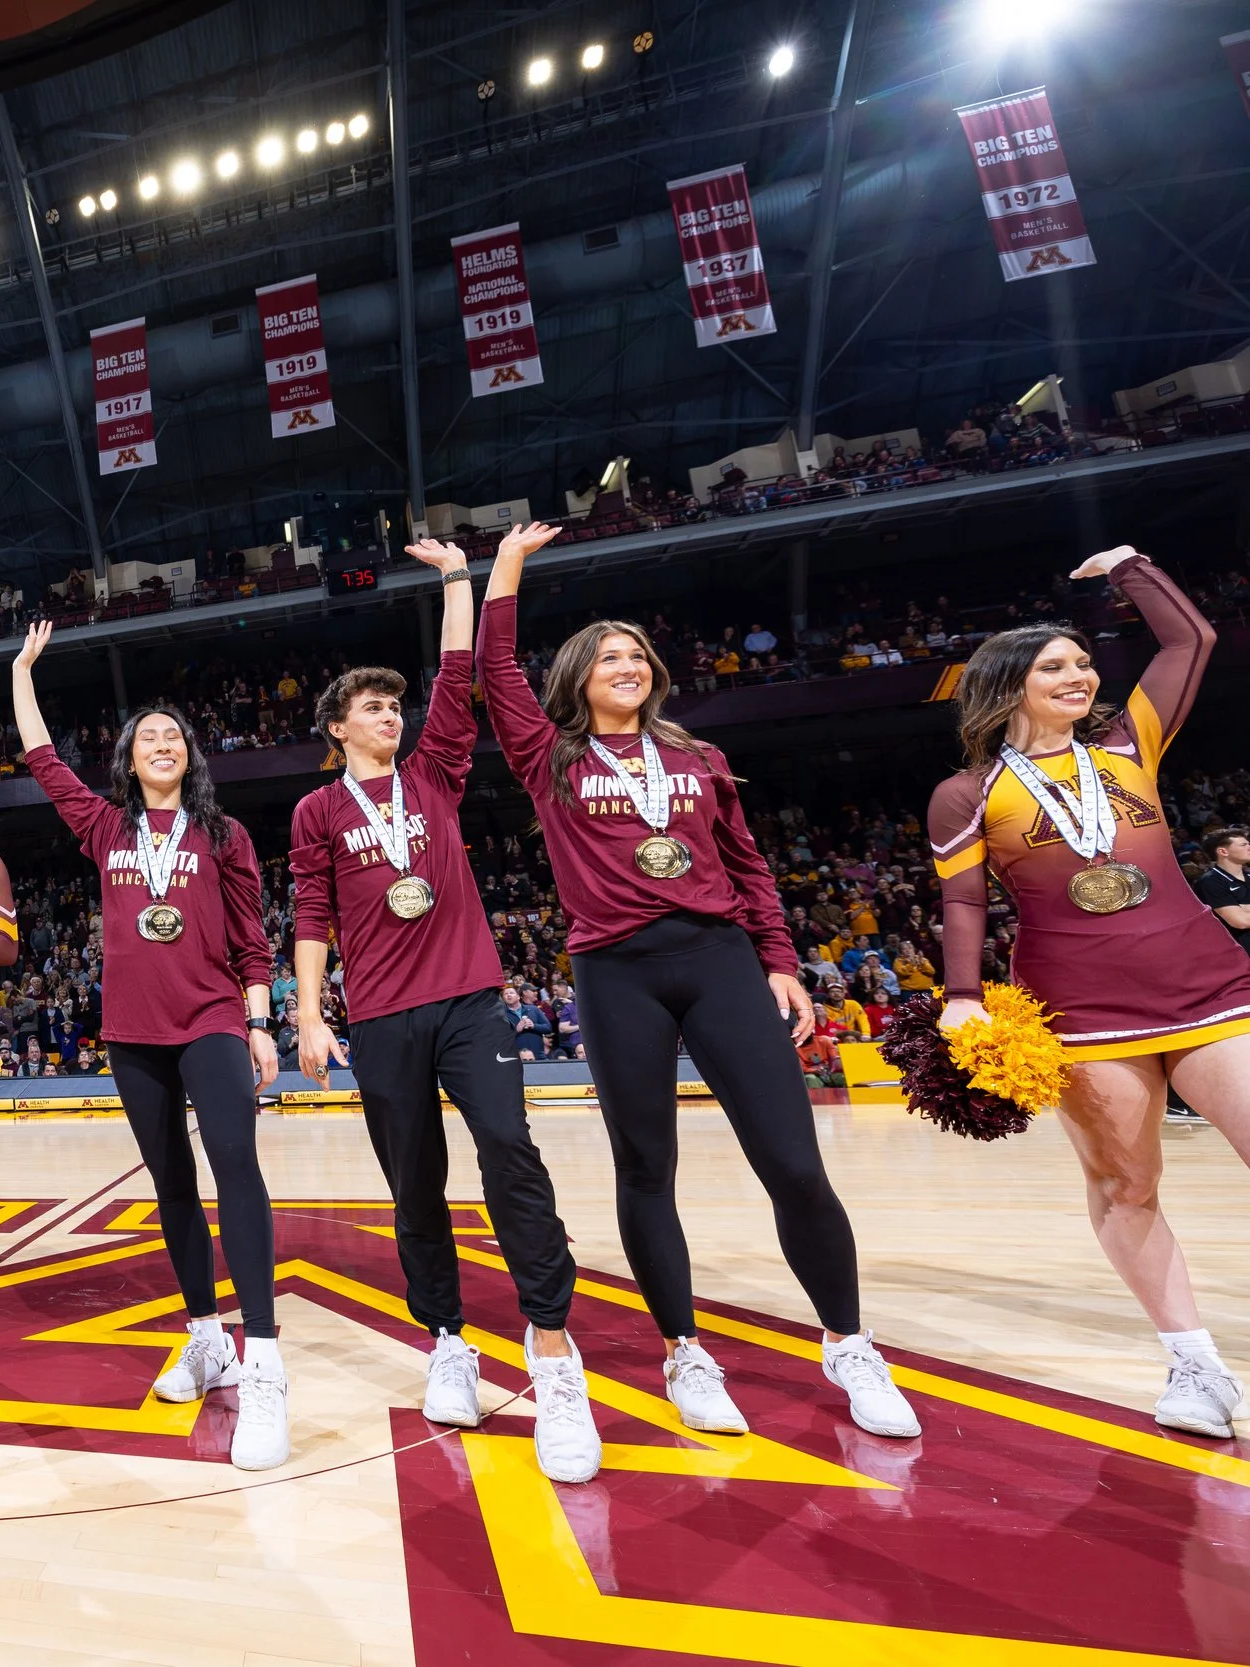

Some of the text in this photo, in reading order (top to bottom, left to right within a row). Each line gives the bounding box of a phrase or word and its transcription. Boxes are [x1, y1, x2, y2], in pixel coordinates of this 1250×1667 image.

[974, 125, 1054, 156] BIG TEN
[977, 141, 1058, 168] CHAMPIONS
[998, 184, 1060, 210] 1972
[679, 199, 746, 228] BIG TEN
[1023, 217, 1053, 229] MEN'S
[681, 214, 750, 239] CHAMPIONS
[1011, 223, 1069, 240] BASKETBALL
[461, 244, 517, 269] HELMS
[697, 254, 748, 277] 1937
[462, 257, 518, 278] FOUNDATION
[463, 281, 525, 305] CHAMPIONS
[468, 274, 518, 294] NATIONAL
[705, 292, 755, 307] BASKETBALL
[264, 305, 318, 330] BIG TEN
[474, 310, 521, 332] 1919
[265, 319, 320, 340] CHAMPIONS
[480, 344, 525, 360] BASKETBALL
[490, 338, 514, 349] MEN'S
[96, 348, 145, 371] BIG TEN
[276, 355, 317, 376] 1919
[96, 361, 146, 381] CHAMPIONS
[280, 388, 320, 402] BASKETBALL
[290, 384, 310, 393] MEN'S
[105, 397, 142, 416] 1917
[108, 428, 144, 441] BASKETBALL
[116, 423, 135, 432] MEN'S
[342, 570, 374, 587] 7:35
[581, 774, 702, 799] MINETA
